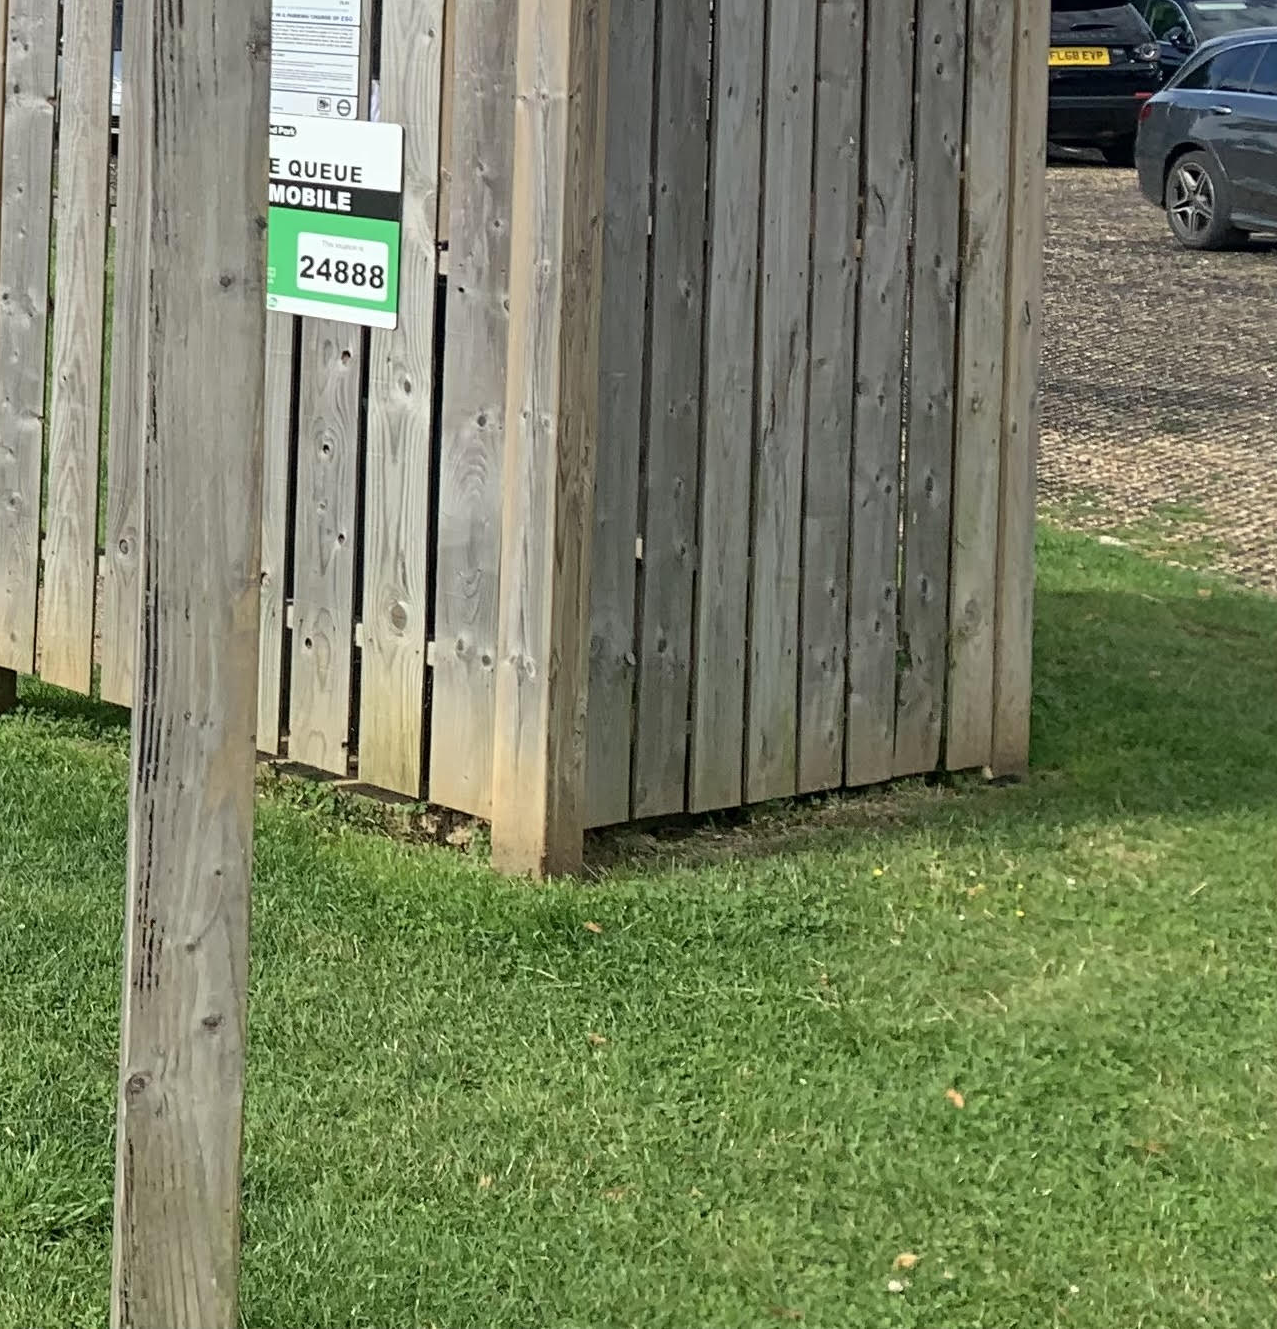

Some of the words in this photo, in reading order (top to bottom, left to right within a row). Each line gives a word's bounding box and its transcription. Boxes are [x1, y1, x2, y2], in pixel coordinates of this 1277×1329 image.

[288, 159, 362, 184] QUEUE
[268, 183, 352, 212] MOBILE
[299, 255, 384, 289] 24888
